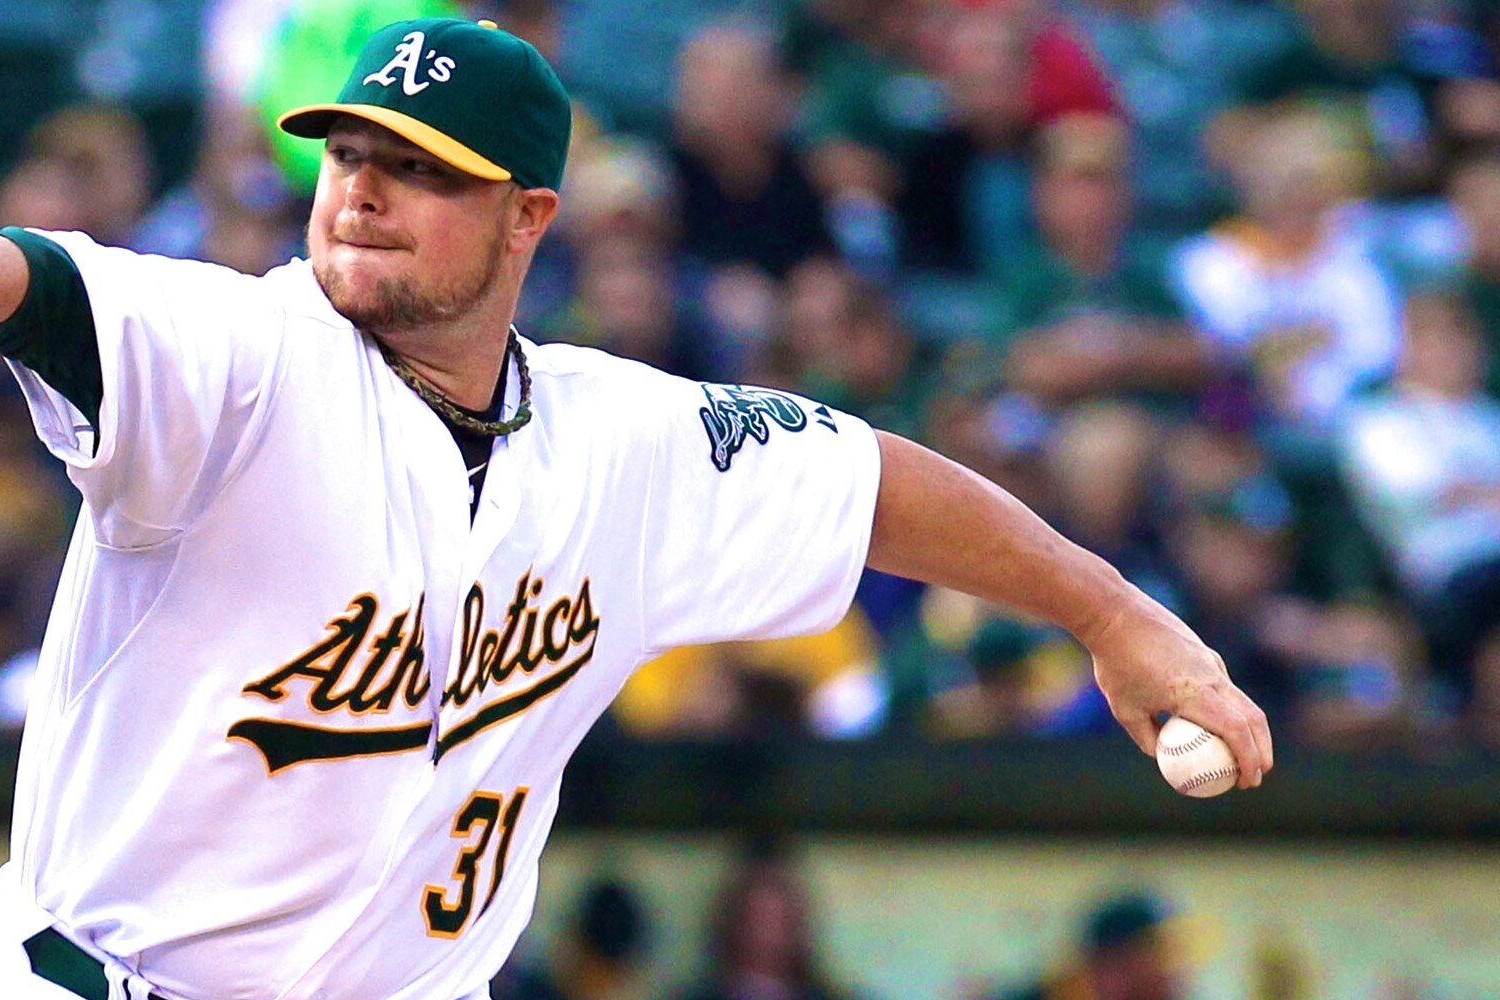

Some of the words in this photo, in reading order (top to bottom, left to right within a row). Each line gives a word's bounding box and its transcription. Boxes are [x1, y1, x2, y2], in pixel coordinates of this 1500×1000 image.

[363, 31, 456, 96] A's
[241, 565, 600, 716] Athletics
[420, 785, 530, 940] 31
